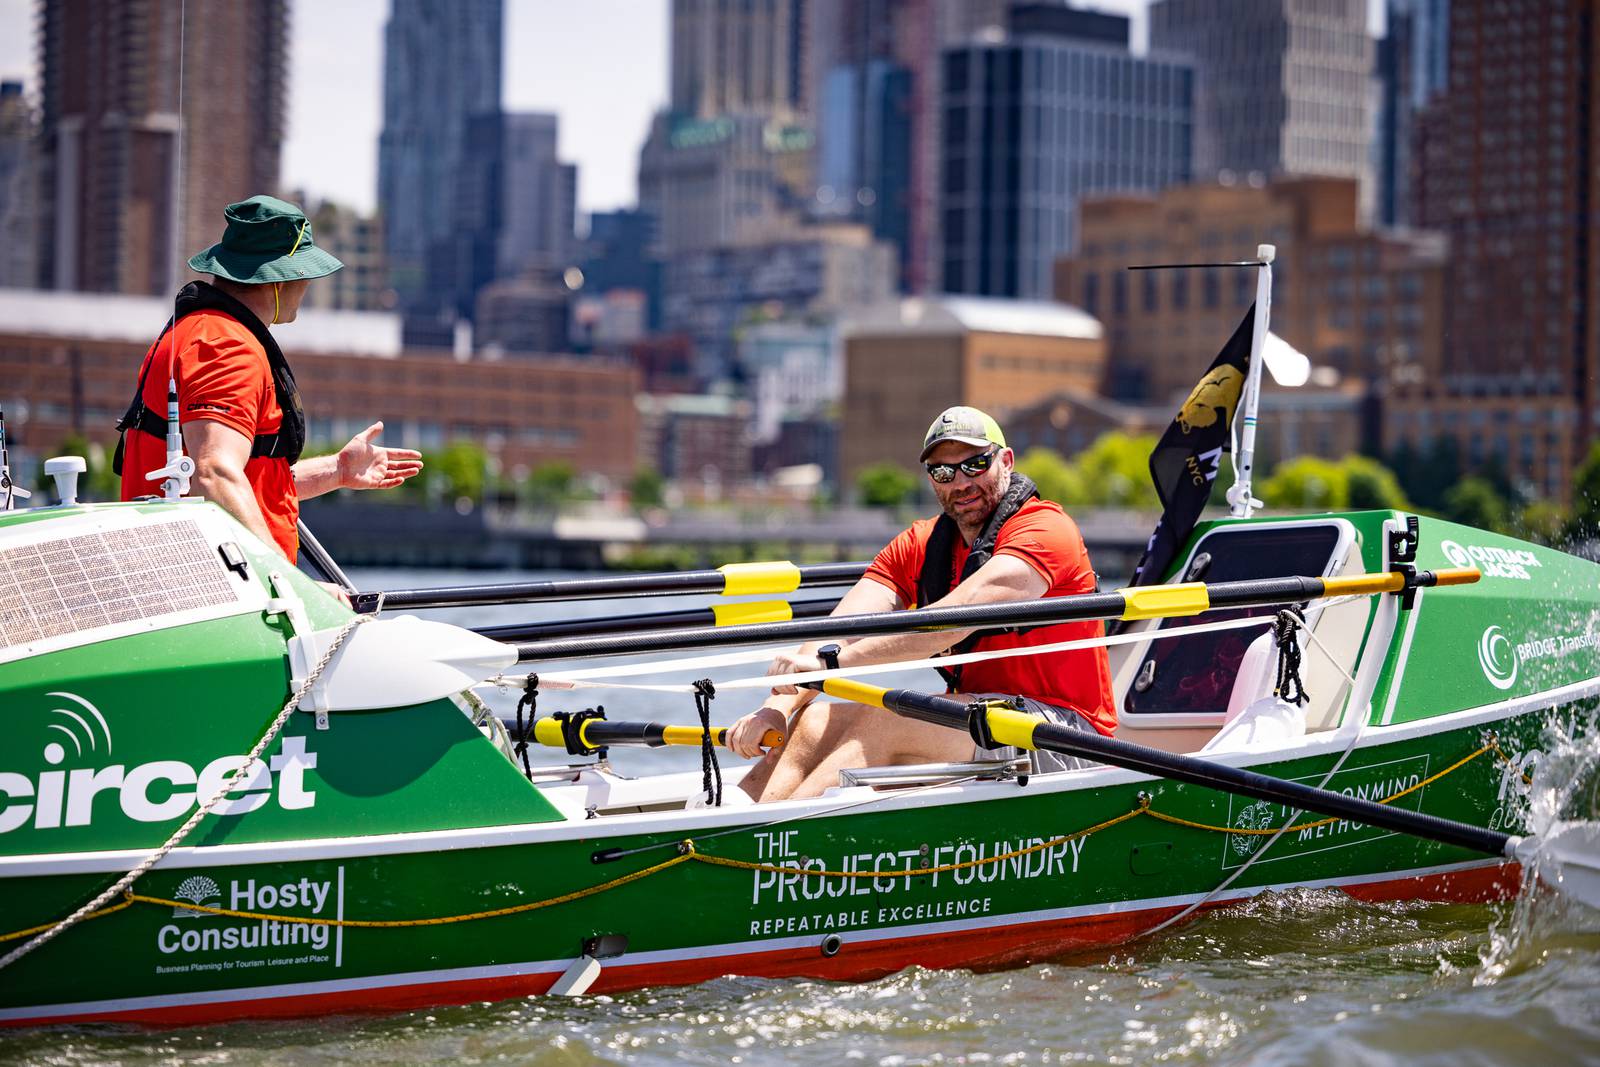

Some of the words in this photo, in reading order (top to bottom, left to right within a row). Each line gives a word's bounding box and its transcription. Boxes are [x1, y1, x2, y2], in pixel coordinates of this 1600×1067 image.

[1185, 456, 1204, 486] NYC
[753, 830, 799, 859] THE
[753, 849, 920, 904] PROJECT
[932, 834, 1092, 888] FOUNDRY
[230, 877, 331, 914] Hosty
[750, 910, 869, 935] REPEATABLE
[878, 898, 992, 923] EXCELLENCE
[158, 918, 330, 954] Consulting
[156, 965, 189, 974] Business
[190, 961, 222, 972] Planning
[223, 960, 234, 969] for
[235, 959, 265, 969] Tourism
[267, 956, 294, 966] Leisure
[294, 955, 308, 964] and
[309, 954, 329, 963] Place
